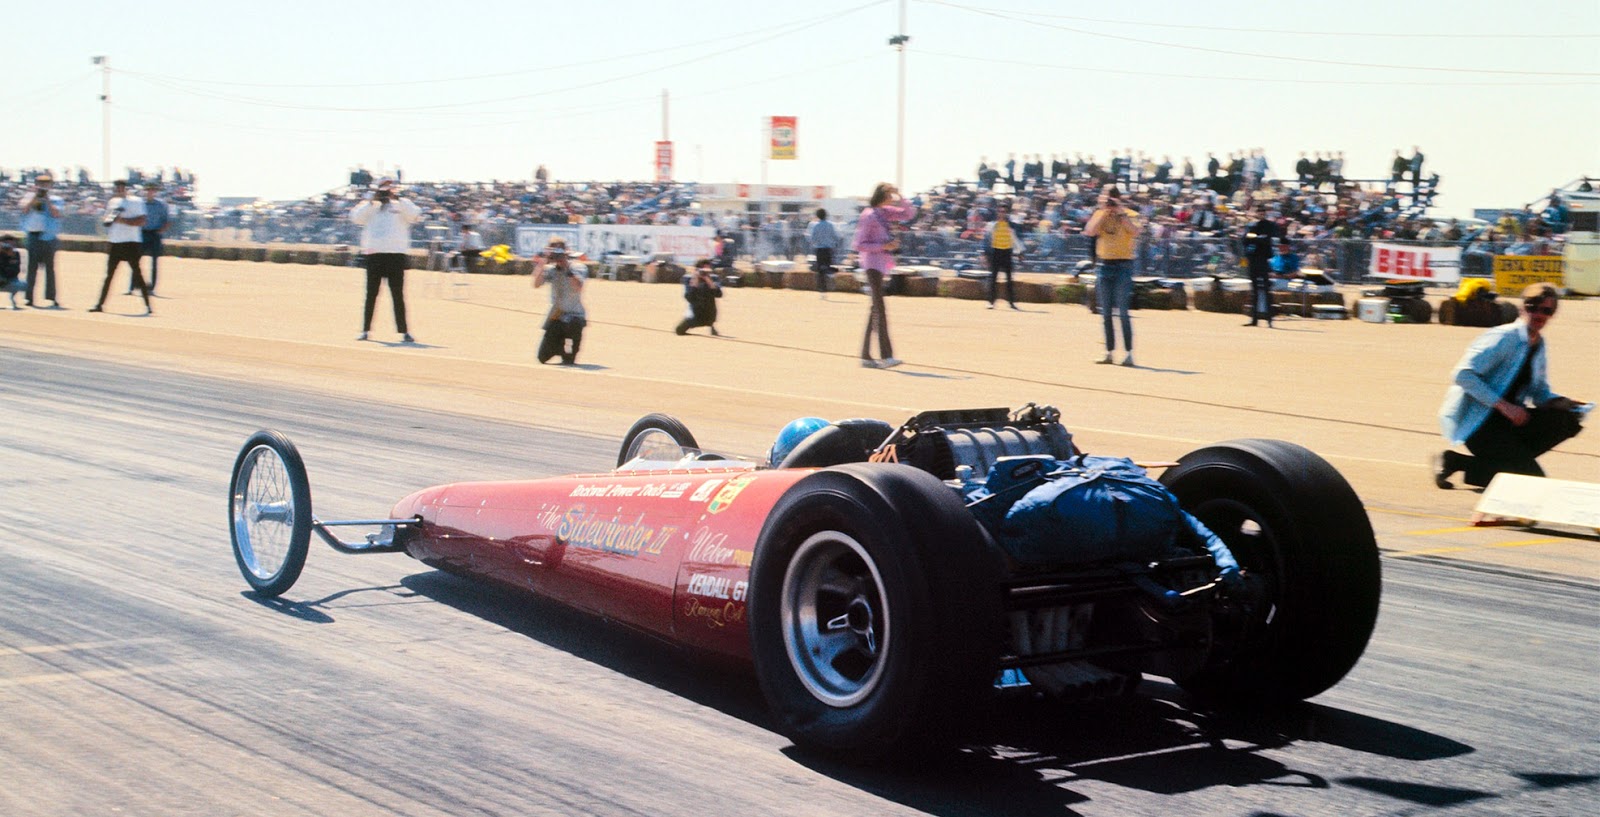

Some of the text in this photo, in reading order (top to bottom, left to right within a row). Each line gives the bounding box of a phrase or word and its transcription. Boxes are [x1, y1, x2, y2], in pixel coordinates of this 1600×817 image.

[1377, 248, 1435, 278] BELL
[569, 484, 608, 497] Rockwell
[605, 484, 641, 497] Power
[636, 483, 666, 497] Tools
[541, 505, 560, 530] the
[555, 503, 655, 556] Sidewinder
[689, 525, 734, 563] Weber
[687, 573, 730, 599] KENDALL
